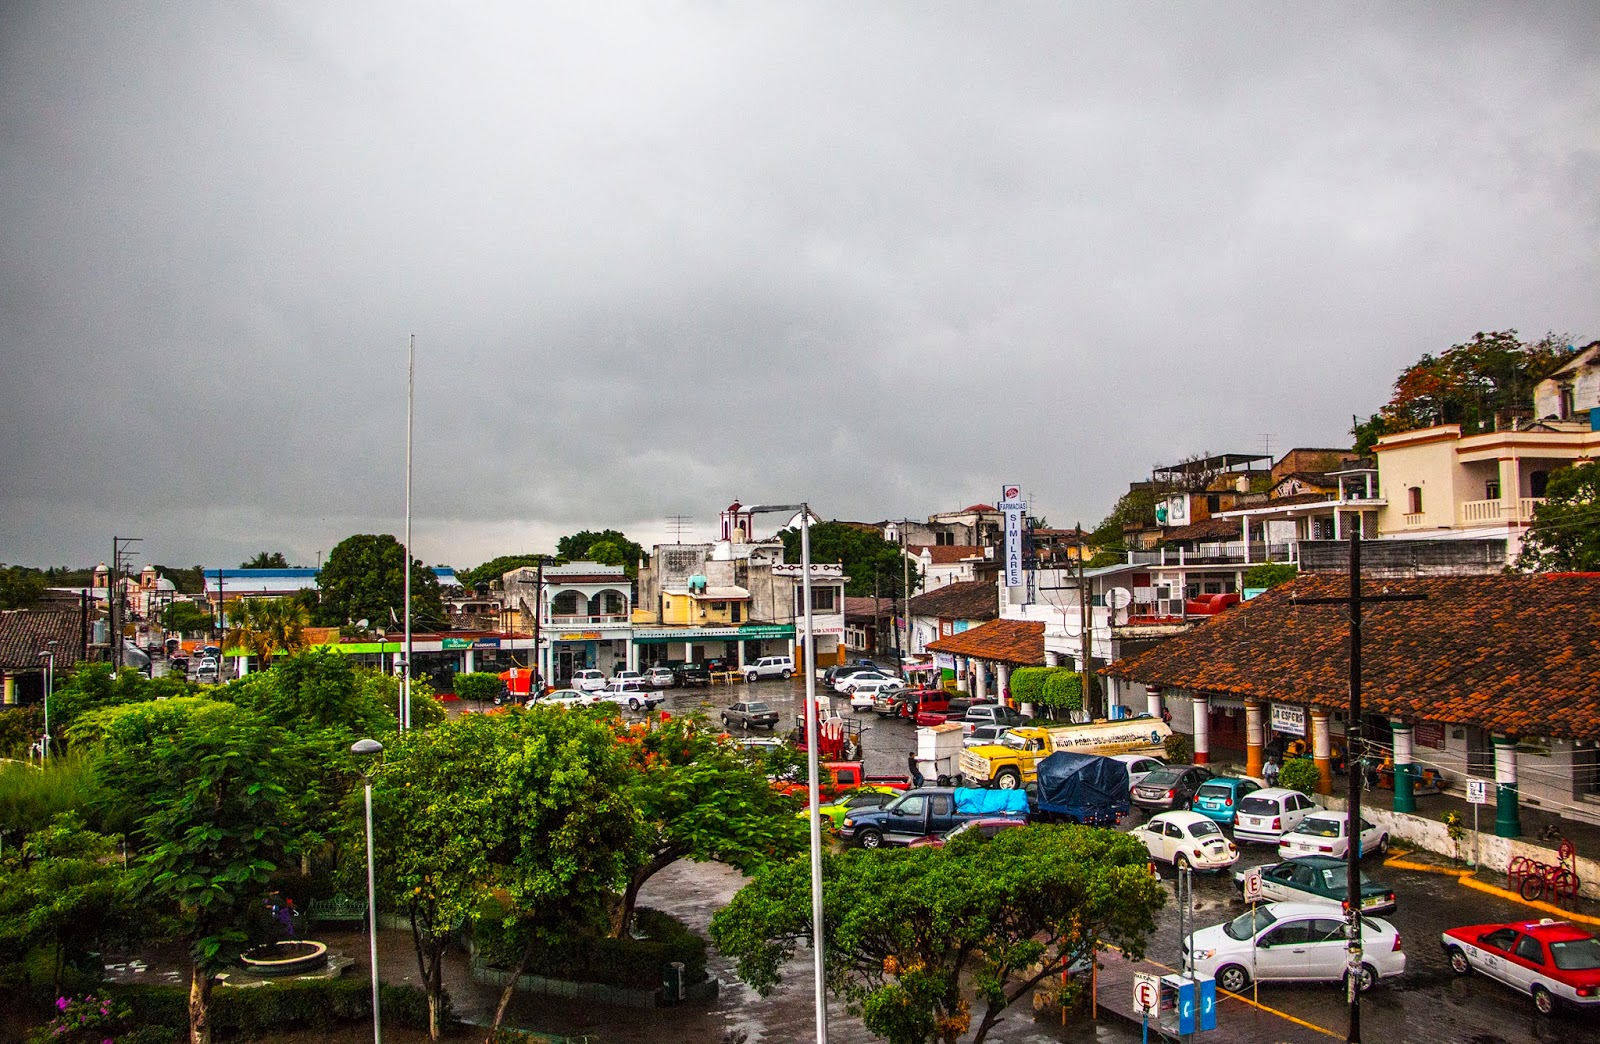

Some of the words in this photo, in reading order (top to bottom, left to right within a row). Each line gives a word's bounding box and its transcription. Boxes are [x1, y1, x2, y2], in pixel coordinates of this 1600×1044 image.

[1010, 514, 1018, 585] SIMILARES
[1281, 711, 1303, 723] ESFERA
[1251, 877, 1258, 892] E
[1141, 986, 1150, 1005] E
